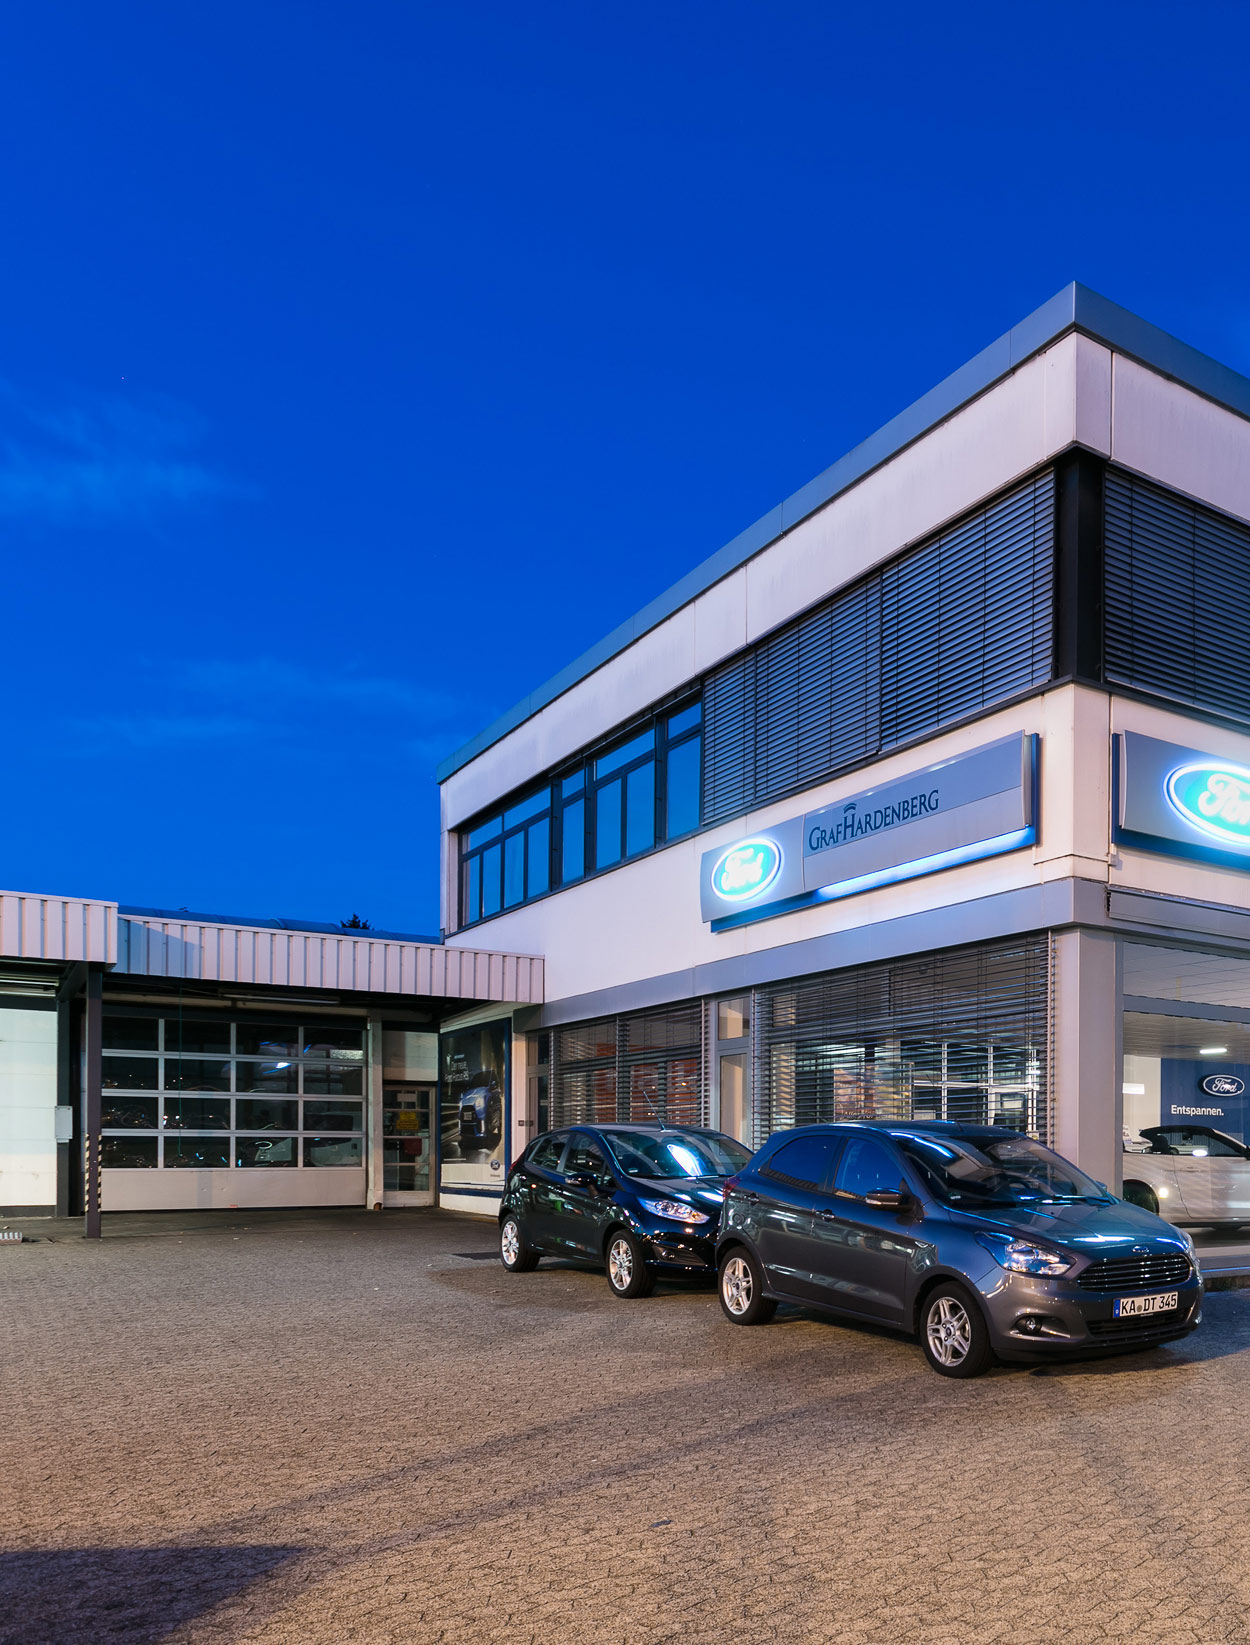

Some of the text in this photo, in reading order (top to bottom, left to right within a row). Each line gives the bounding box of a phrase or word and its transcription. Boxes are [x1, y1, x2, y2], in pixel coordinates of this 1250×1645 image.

[1211, 1077, 1238, 1093] Ford
[1170, 1104, 1225, 1117] Entspannen.
[1121, 1294, 1177, 1315] KA DT 345
